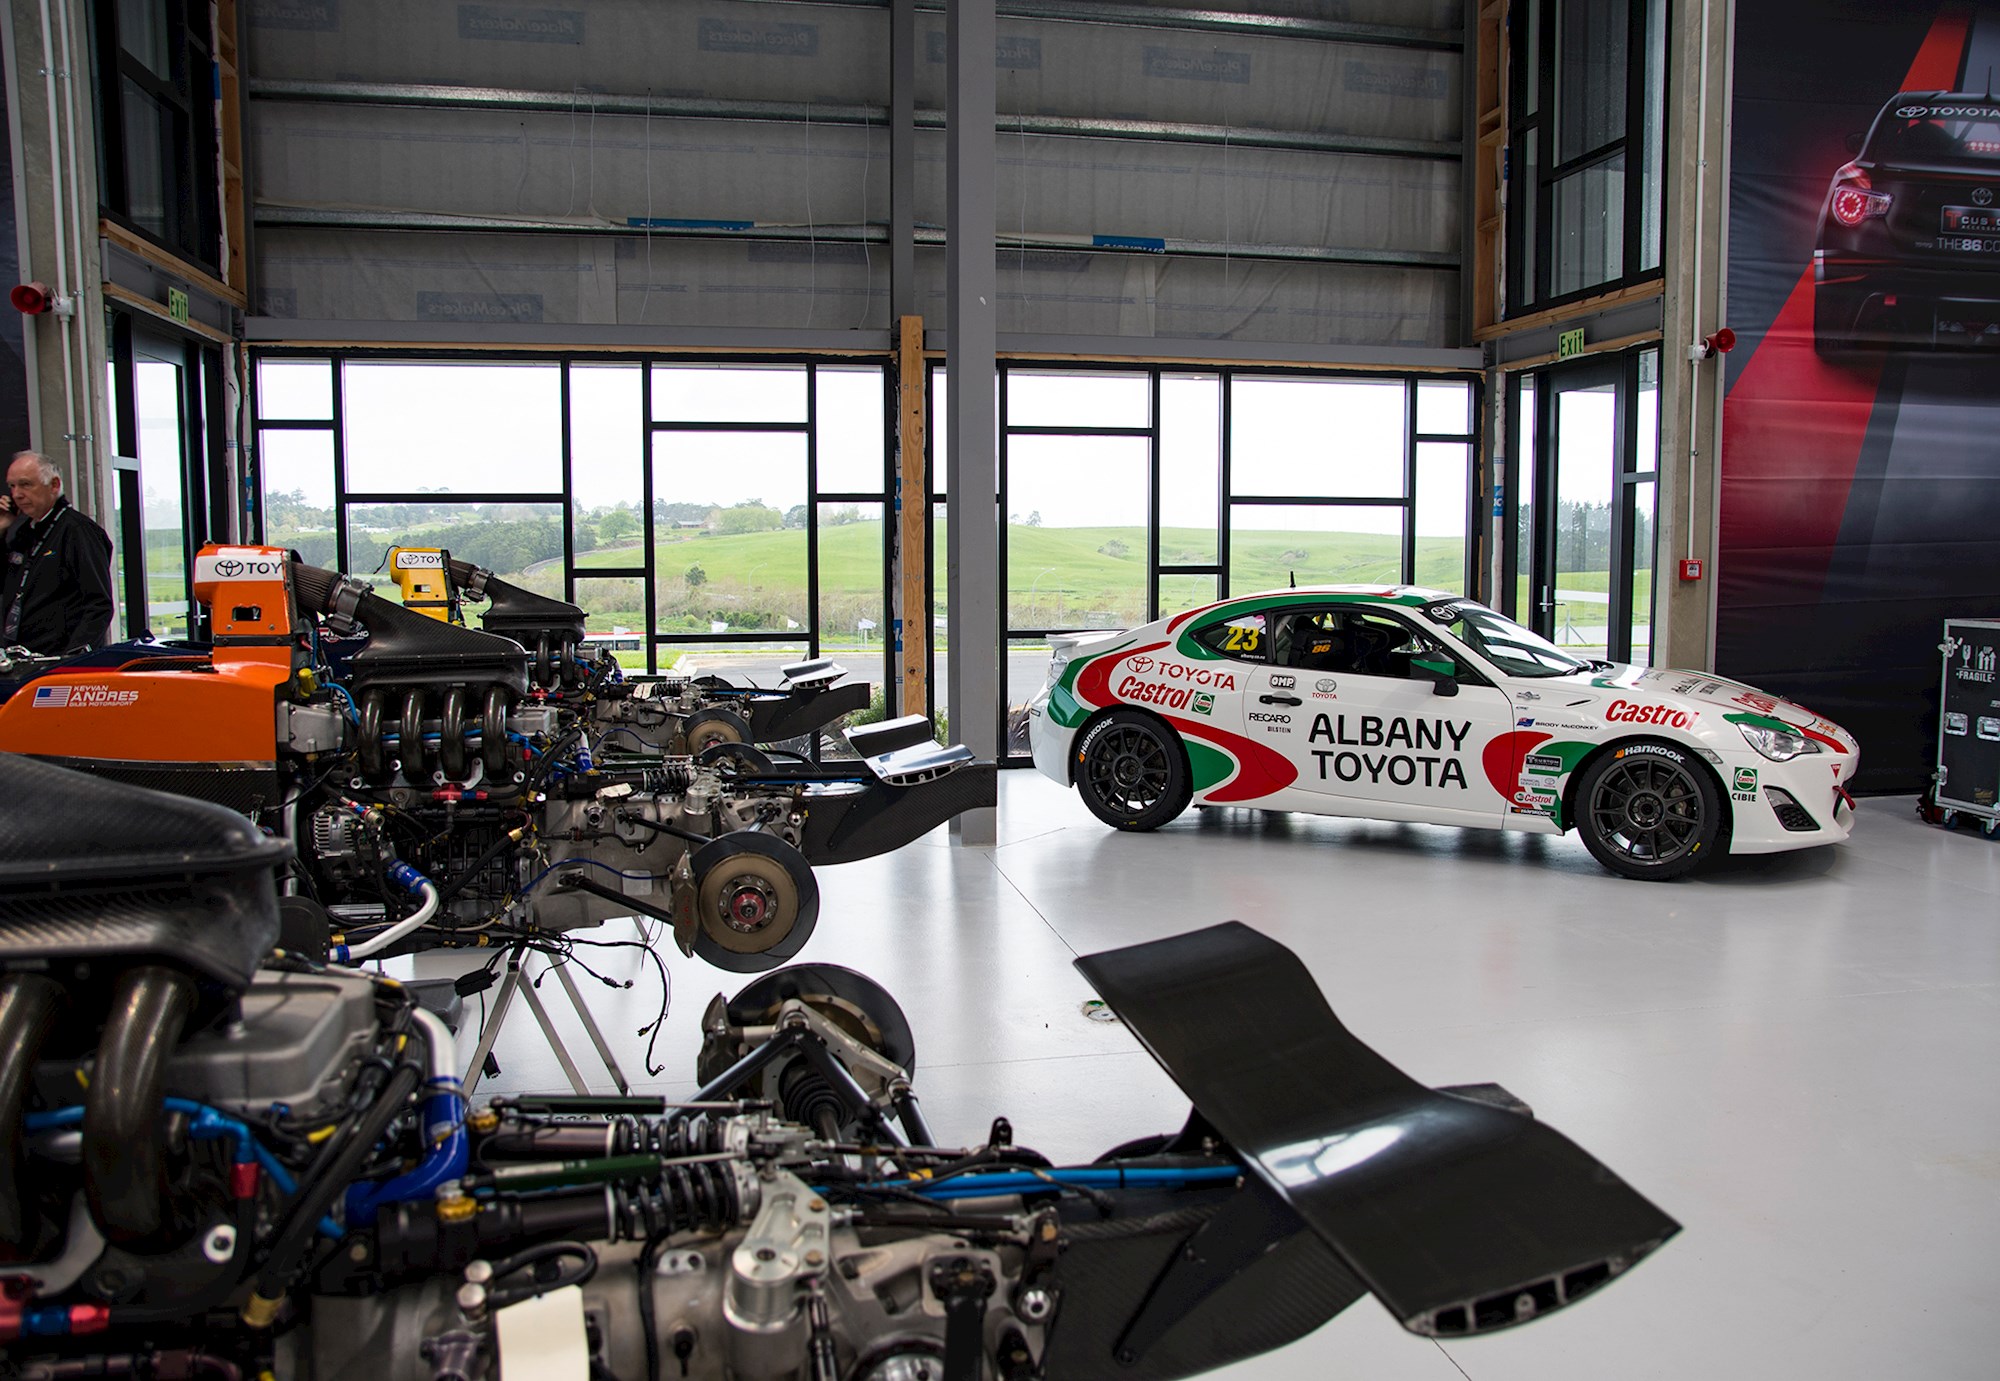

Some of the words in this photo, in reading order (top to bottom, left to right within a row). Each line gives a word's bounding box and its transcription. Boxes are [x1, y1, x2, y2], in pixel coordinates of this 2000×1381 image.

[1929, 107, 2000, 117] TOYOTA
[170, 289, 187, 322] Exit
[1560, 331, 1583, 358] Exit
[1225, 626, 1259, 651] 23
[1158, 661, 1236, 691] TOYOTA
[1958, 670, 1993, 683] FRAGILE
[70, 691, 139, 702] ANDRES
[1117, 675, 1195, 710] Castrol
[1312, 692, 1338, 700] TOYOTA
[1248, 712, 1291, 724] RECARO
[1605, 699, 1700, 731] Castrol
[1308, 713, 1472, 751] ALBANY
[1311, 750, 1468, 790] TOYOTA
[1524, 794, 1552, 804] Castrol
[1731, 792, 1757, 802] CIBIE
